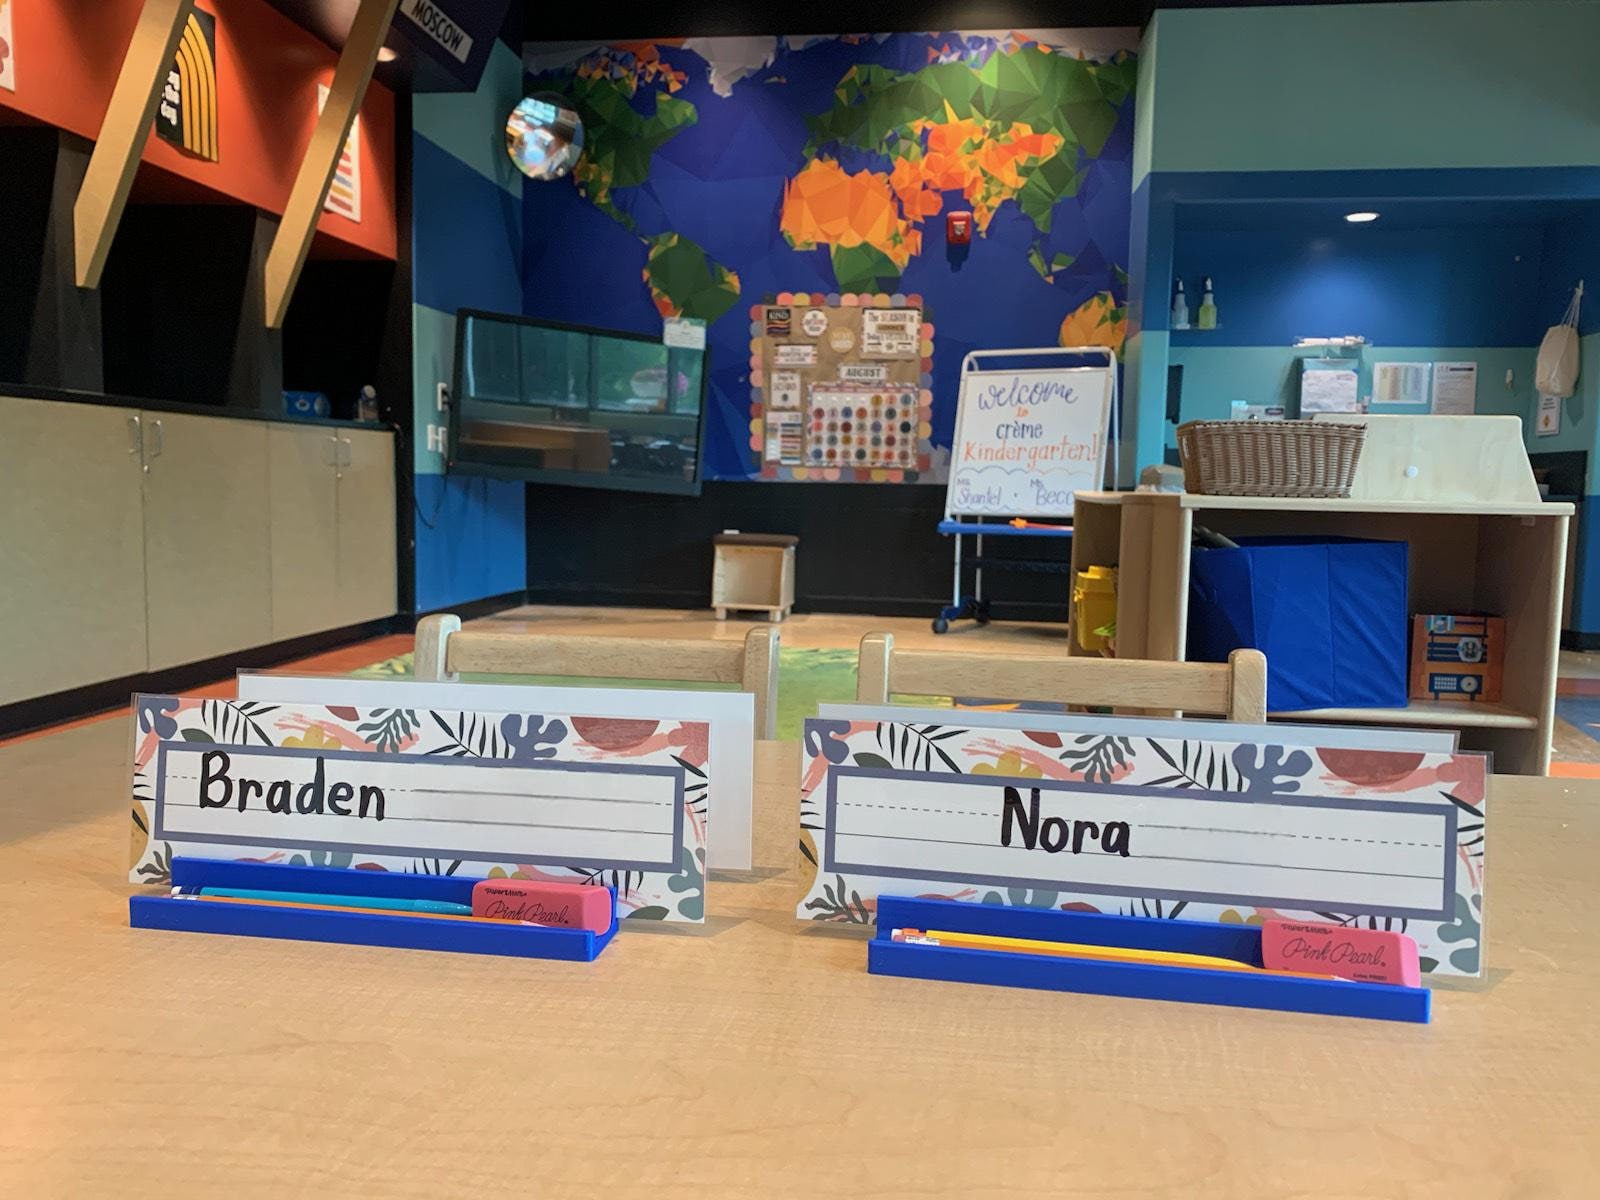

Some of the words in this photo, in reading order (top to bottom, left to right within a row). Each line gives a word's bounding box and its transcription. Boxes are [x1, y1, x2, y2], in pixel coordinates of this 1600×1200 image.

[411, 0, 464, 52] MOSCOW
[847, 368, 880, 377] AUGUST
[978, 377, 1078, 410] welcome
[1016, 406, 1029, 417] to
[996, 420, 1043, 440] crème
[963, 432, 1098, 470] Kindergarten!
[200, 751, 385, 821] Braden
[1001, 786, 1131, 858] Nora
[485, 900, 526, 920] Pink
[1282, 937, 1332, 960] Pink
